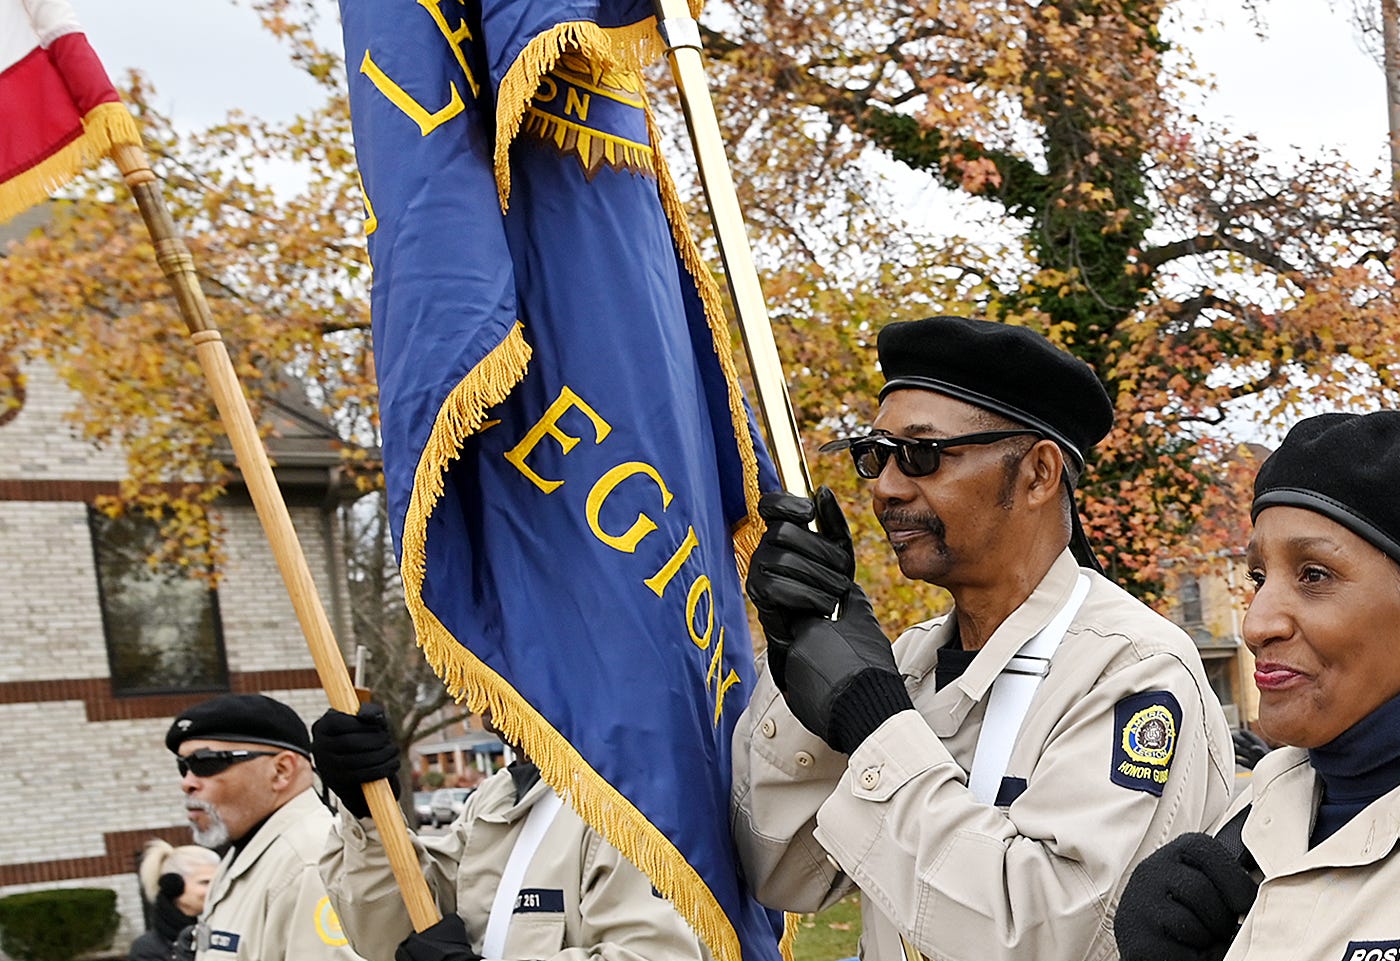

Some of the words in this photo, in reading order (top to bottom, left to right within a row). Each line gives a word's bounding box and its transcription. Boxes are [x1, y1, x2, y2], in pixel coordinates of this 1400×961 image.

[503, 385, 741, 728] EGION
[1118, 761, 1152, 780] HONOR
[523, 893, 540, 908] 261
